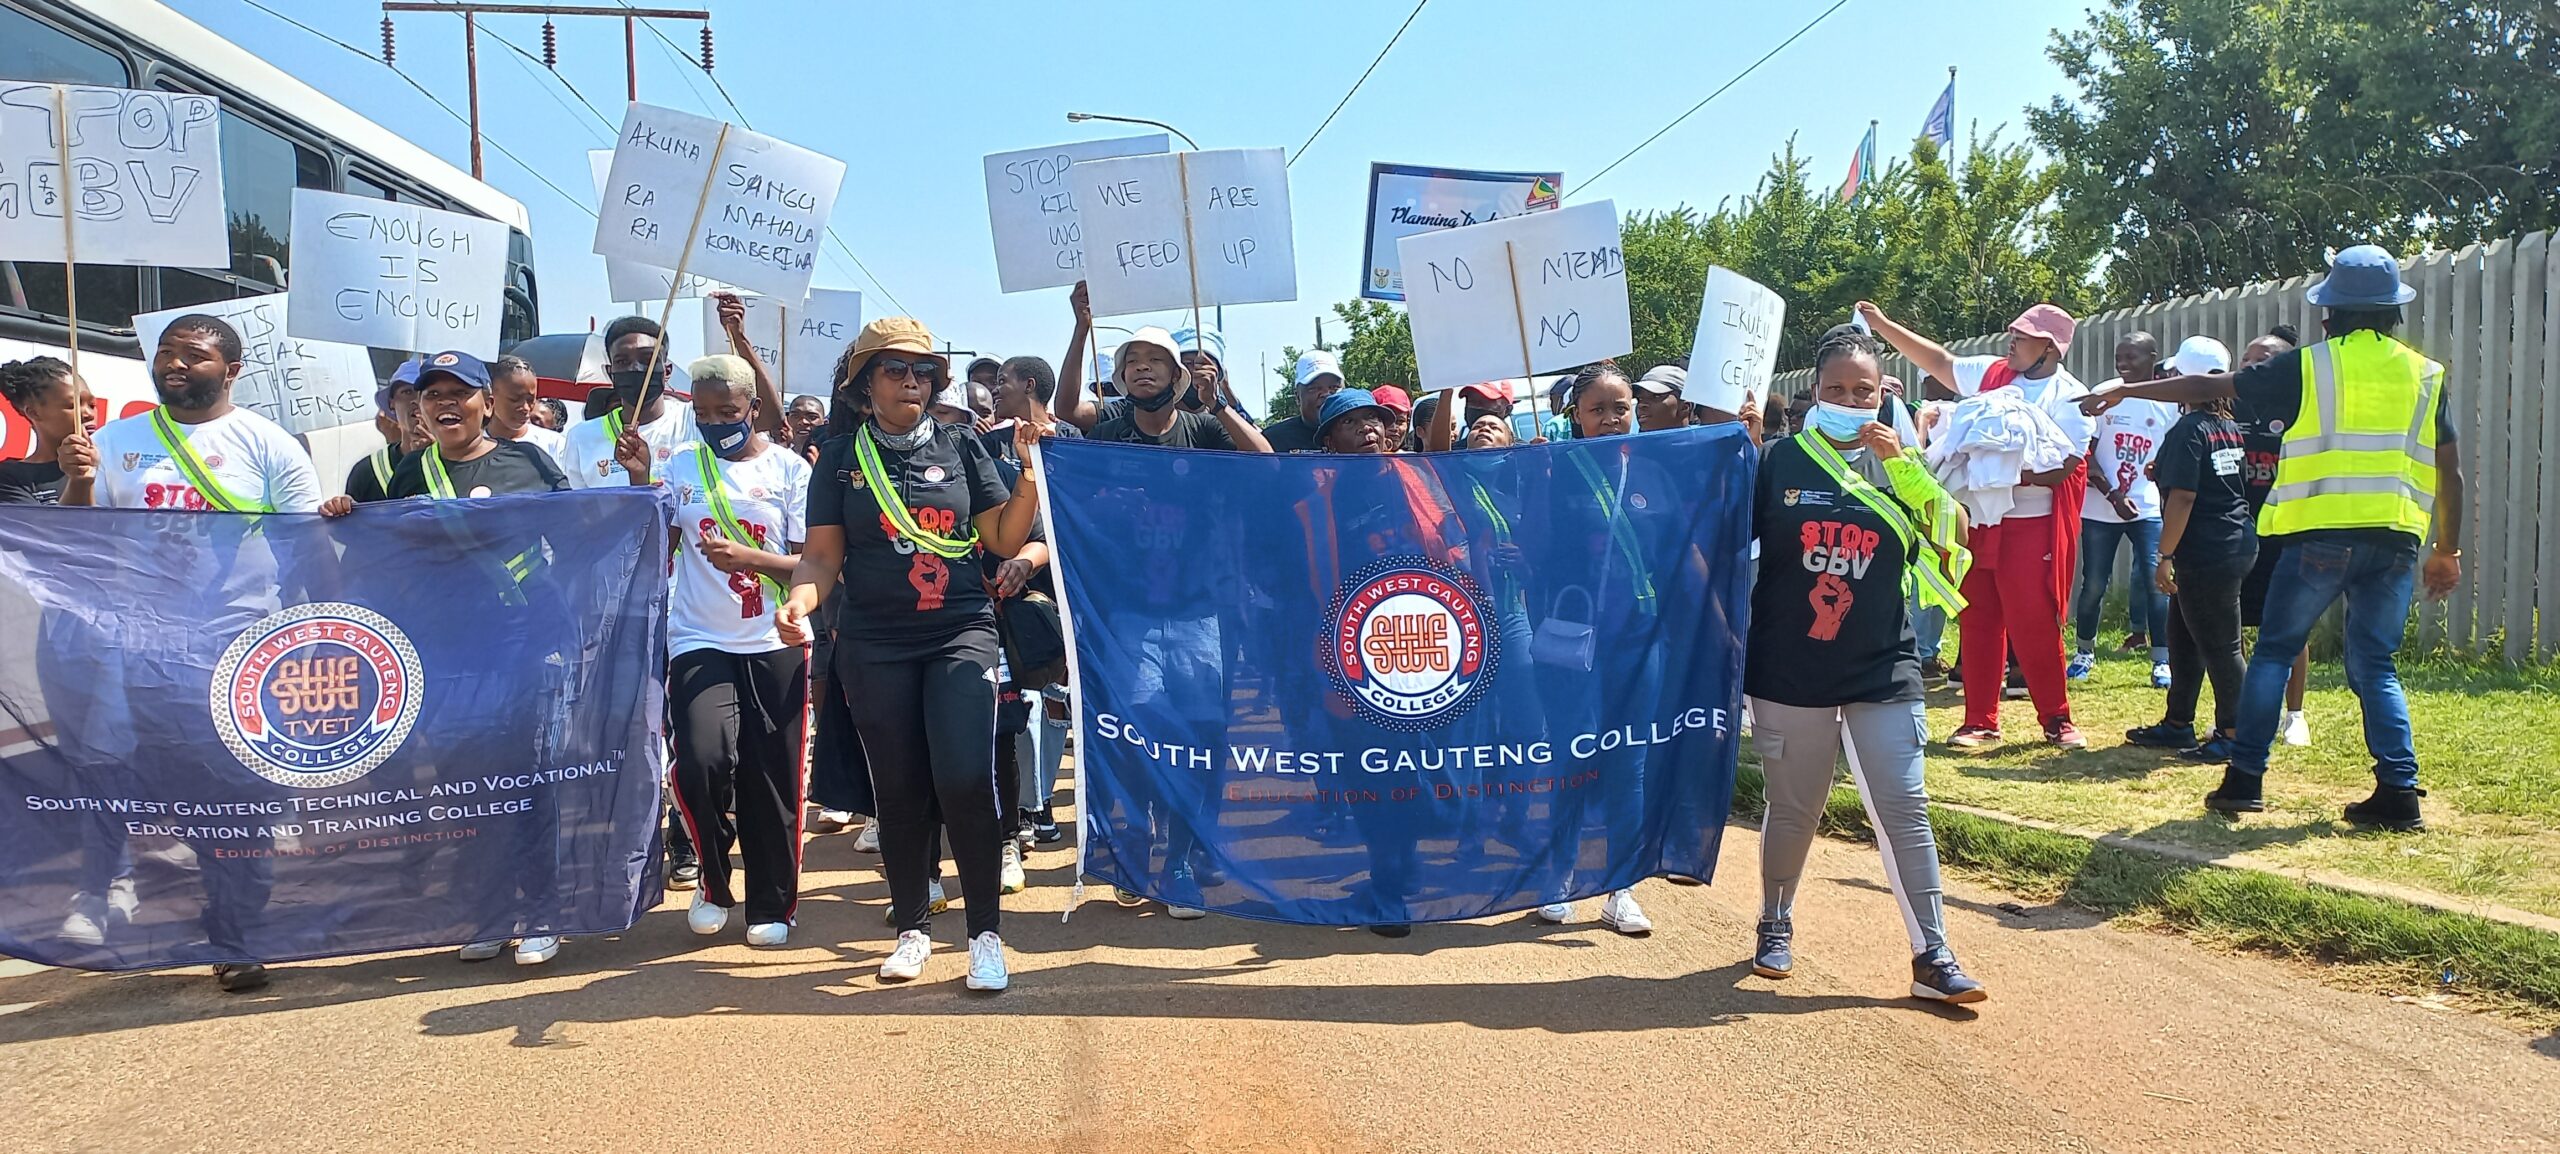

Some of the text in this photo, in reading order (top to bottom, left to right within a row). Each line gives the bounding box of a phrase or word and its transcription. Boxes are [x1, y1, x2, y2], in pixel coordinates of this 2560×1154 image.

[628, 120, 700, 161] AKUNA
[0, 157, 200, 224] BV
[1005, 154, 1071, 193] STOP
[624, 184, 655, 207] RA
[1098, 180, 1259, 211] WE ARE
[326, 213, 470, 255] ENOUGH
[630, 217, 660, 241] RA
[722, 203, 815, 244] MAHALA
[1391, 205, 1459, 229] Planning
[379, 255, 439, 283] IS
[1056, 250, 1085, 270] CH
[1116, 238, 1257, 277] FEED UP
[1428, 257, 1474, 293] NO
[335, 288, 479, 329] ENOUGH
[799, 317, 844, 341] ARE
[1538, 308, 1581, 348] NO
[239, 341, 317, 368] REAK
[238, 367, 304, 393] THE
[2114, 432, 2152, 452] STOP
[2115, 445, 2149, 465] GBV
[699, 517, 767, 546] SOP
[1801, 520, 1880, 559] STOP
[1802, 545, 1875, 580] GBV
[1343, 577, 1480, 667] SOUTH WEST GAUTENG
[239, 625, 398, 718] SOUTH WEST GAUTENG
[1370, 683, 1460, 712] COLLEGE
[284, 716, 356, 737] TVET
[1096, 706, 1729, 775] SOUTH WEST GAUTENG COLLEGE
[270, 732, 373, 766] COLLEGE
[25, 794, 104, 812] SOUTH
[104, 797, 169, 816] WEST
[173, 799, 284, 819] GAUTENG
[287, 787, 424, 813] TECHNICAL
[429, 780, 478, 798] AND
[482, 758, 618, 792] VOCATIONAL
[1228, 769, 1600, 804] EDUCATION OF DISTINCTION
[124, 796, 534, 840] EDUCATION AND TRAINING COLLEGE
[214, 826, 479, 860] EDUCATION OF DISTINCTION
